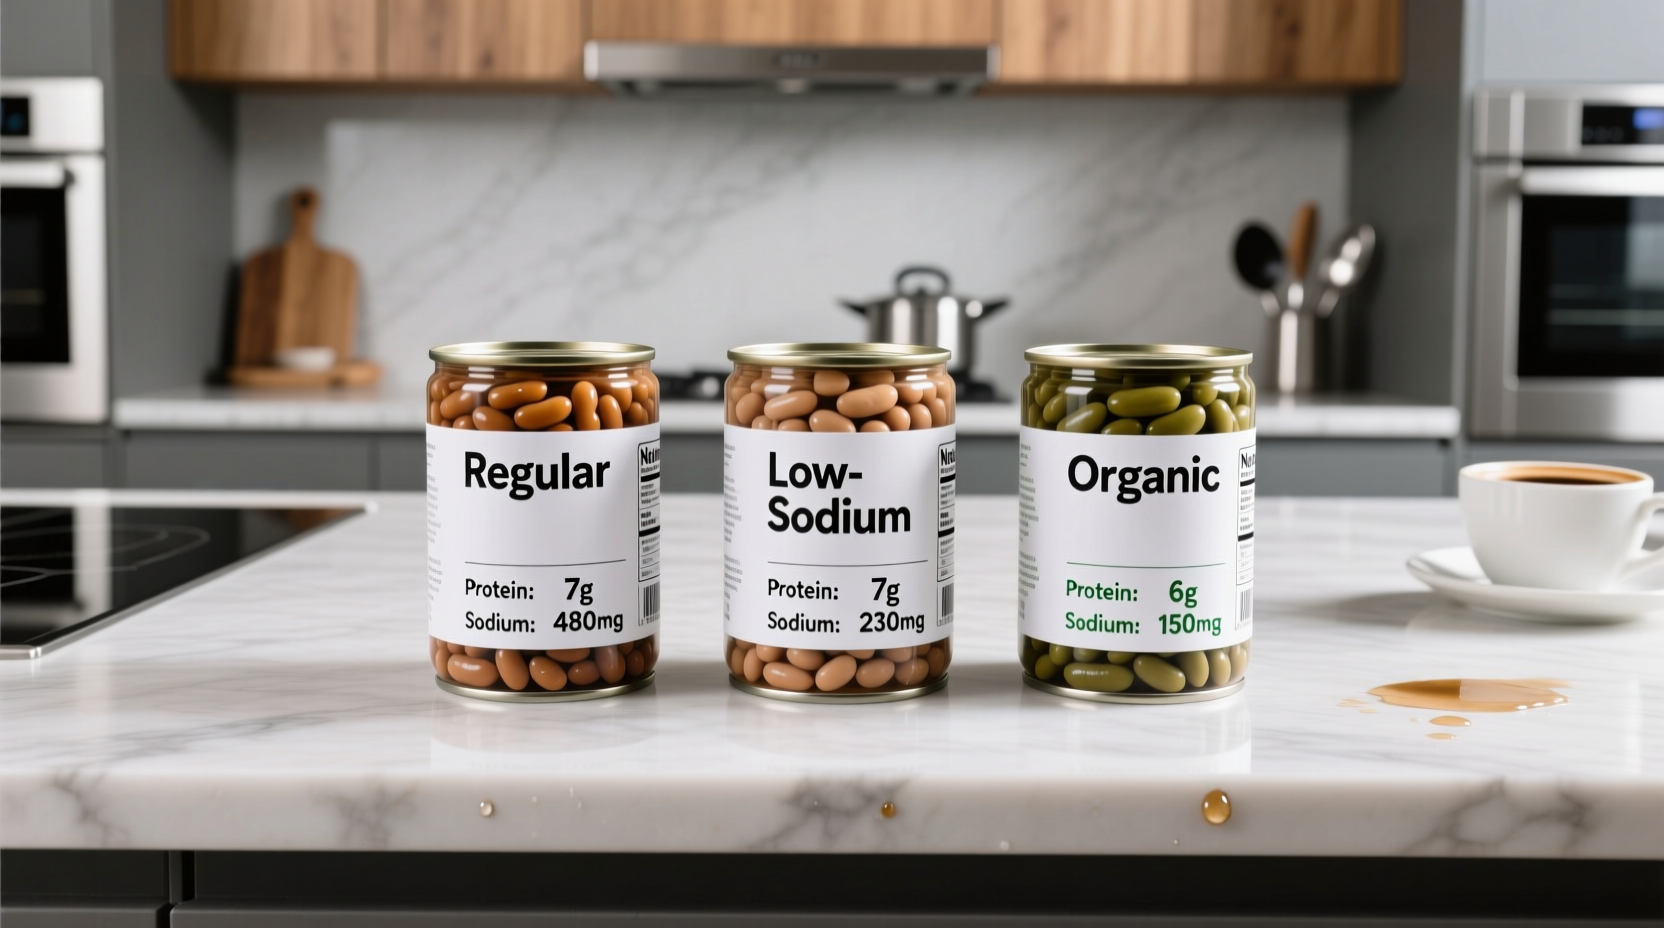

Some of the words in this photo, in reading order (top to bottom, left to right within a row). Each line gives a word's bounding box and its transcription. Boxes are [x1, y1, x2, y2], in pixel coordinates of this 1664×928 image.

[464, 451, 611, 501] Regular
[769, 451, 863, 490] Low-
[1067, 454, 1220, 505] Organic
[767, 495, 911, 535] Sodium
[465, 578, 534, 600] Protein:
[564, 577, 594, 607] 7g
[768, 578, 839, 601] Protein:
[871, 576, 901, 608] 7g
[1066, 579, 1138, 602] Protein:
[1168, 579, 1198, 609] 6g
[465, 610, 536, 634] Sodium:
[552, 610, 624, 634] 480mg
[767, 610, 840, 634] Sodium:
[859, 610, 925, 634] 230mg
[1065, 611, 1140, 635] Sodium:
[1158, 612, 1222, 637] 150mg
